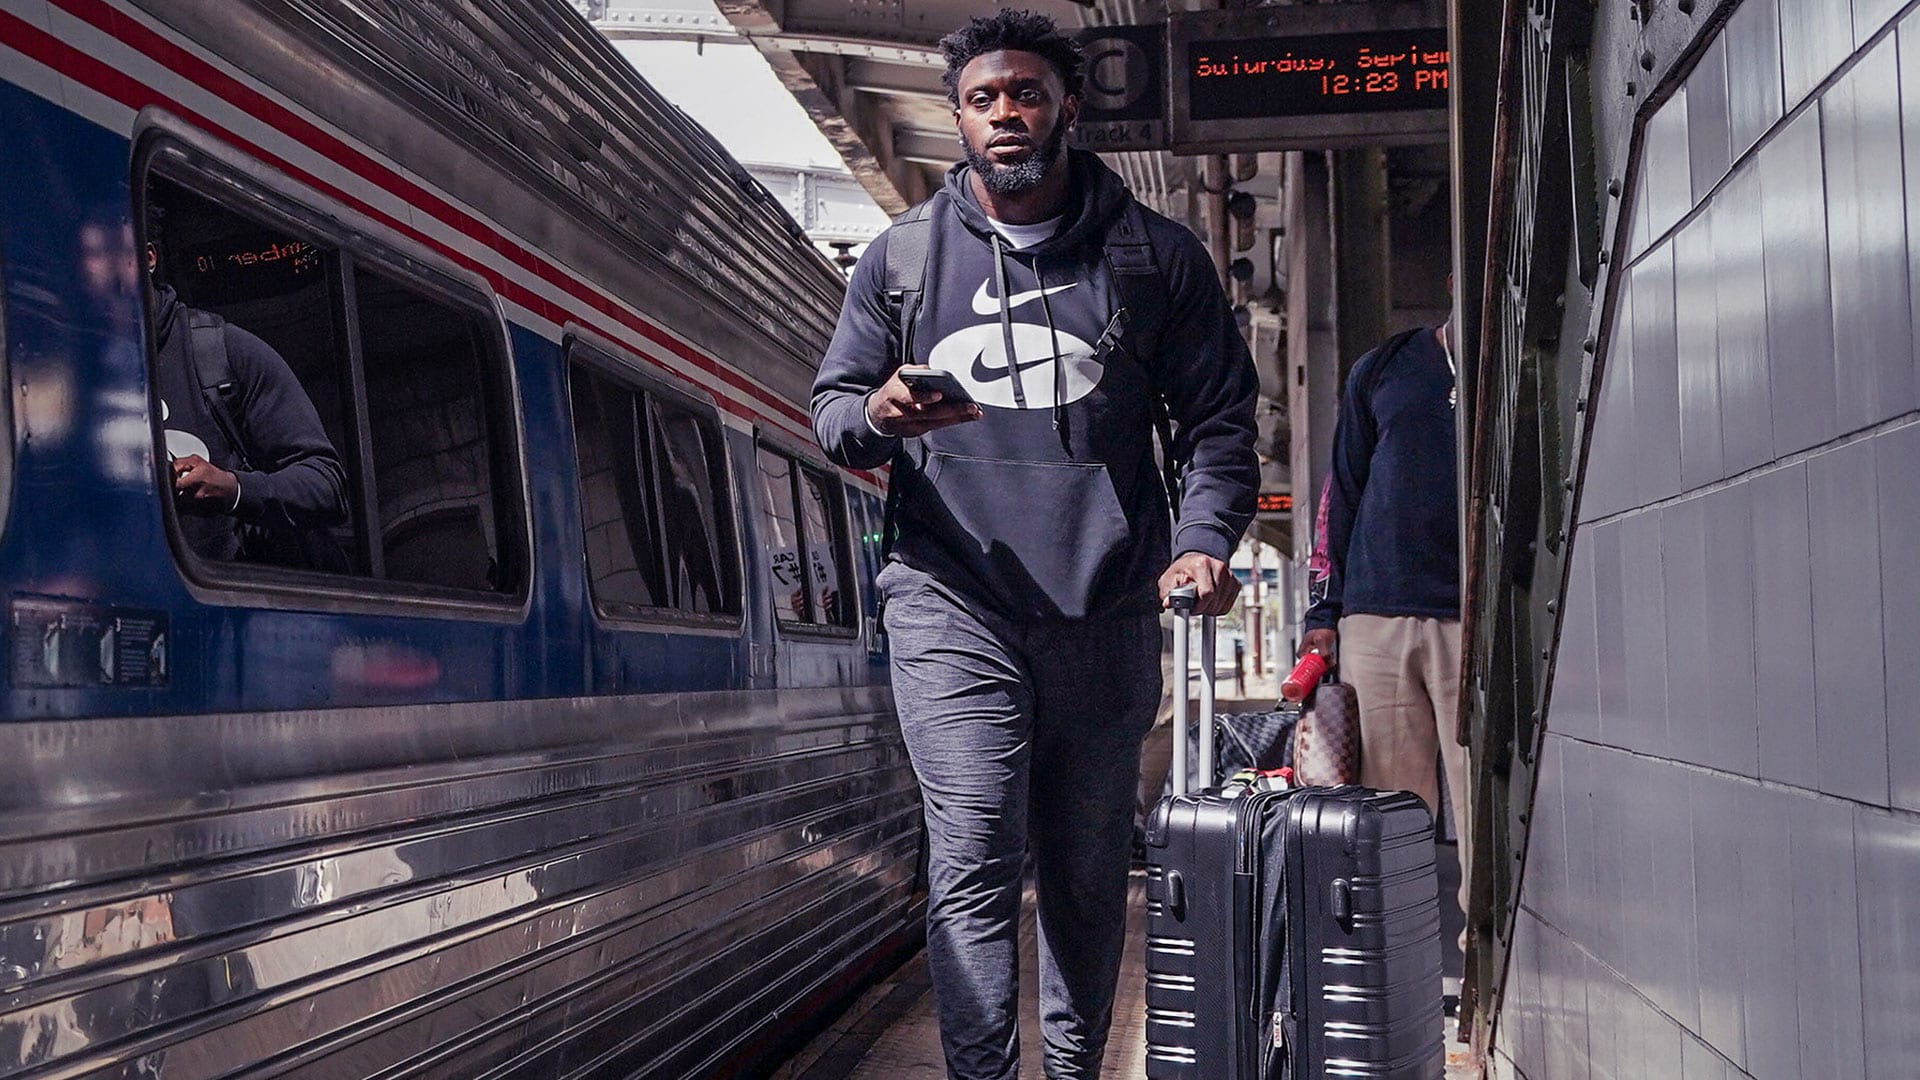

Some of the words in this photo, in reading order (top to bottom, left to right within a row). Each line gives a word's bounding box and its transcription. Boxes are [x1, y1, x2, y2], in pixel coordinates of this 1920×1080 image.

[1089, 49, 1126, 96] C
[1321, 71, 1399, 95] 12:23
[1414, 69, 1449, 90] PM
